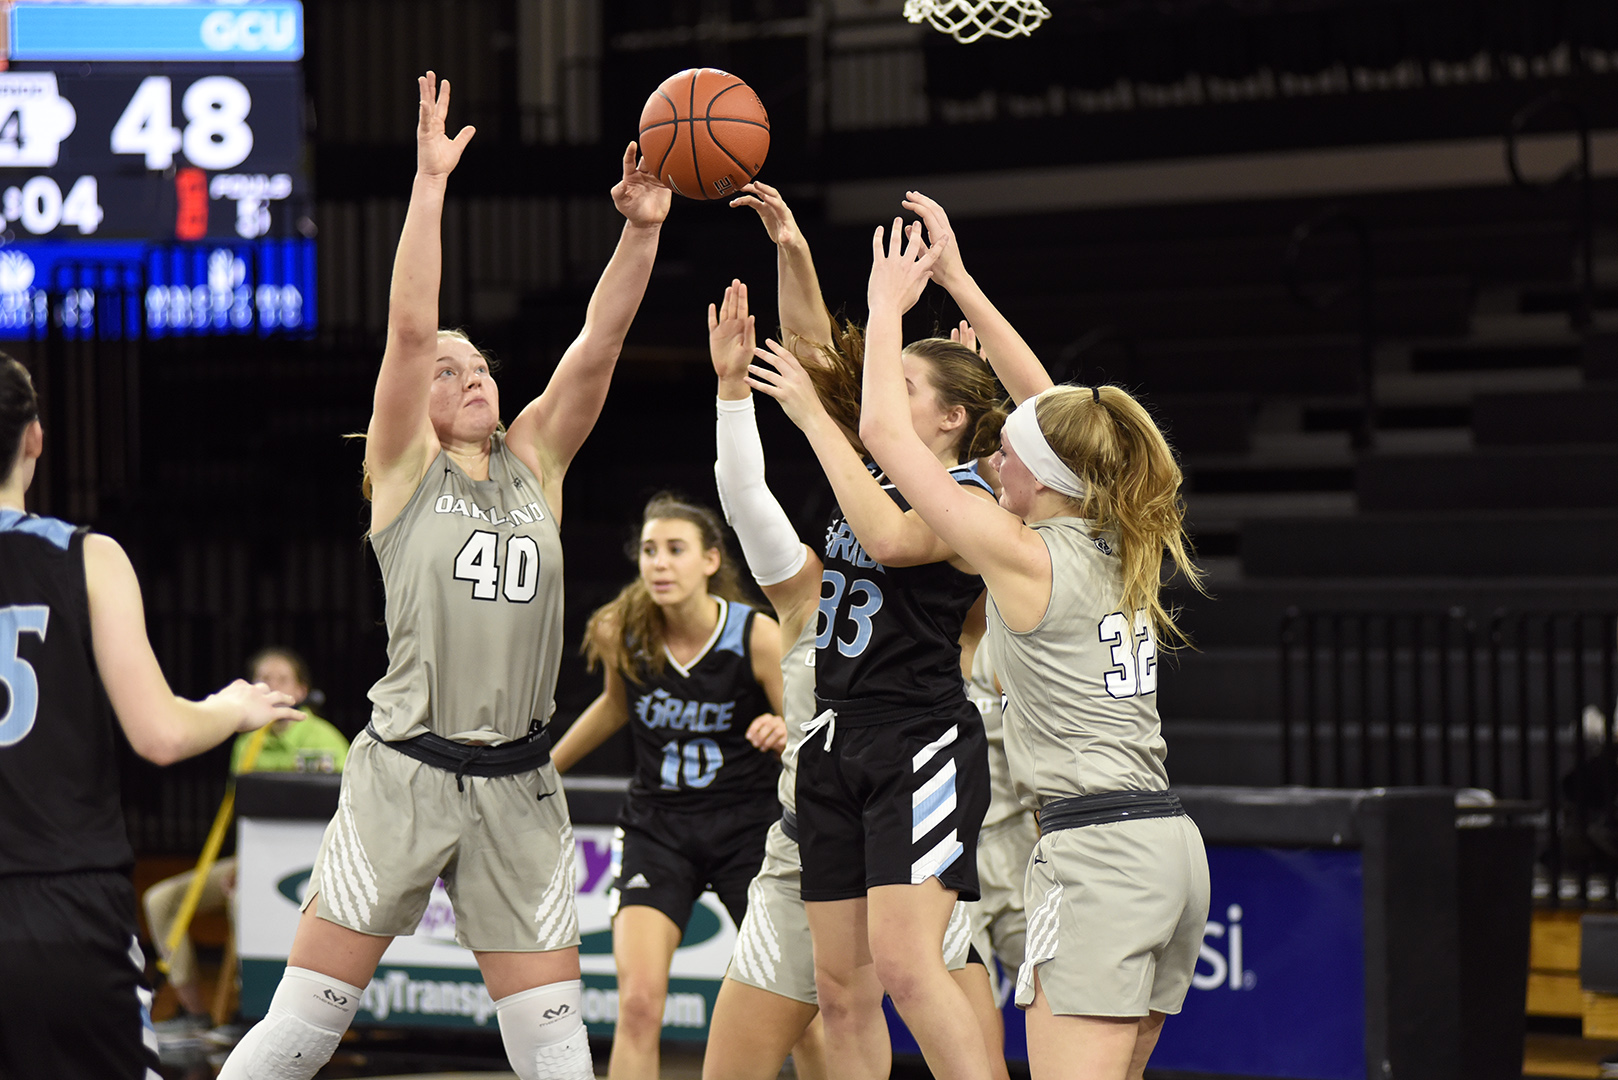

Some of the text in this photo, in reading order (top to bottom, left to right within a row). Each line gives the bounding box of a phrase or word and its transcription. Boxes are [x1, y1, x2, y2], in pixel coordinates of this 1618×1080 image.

[110, 75, 253, 170] 48
[434, 493, 545, 527] OAKLND
[453, 529, 540, 604] 40
[1098, 607, 1157, 699] 32
[634, 687, 736, 733] GRACE
[660, 738, 724, 791] 10
